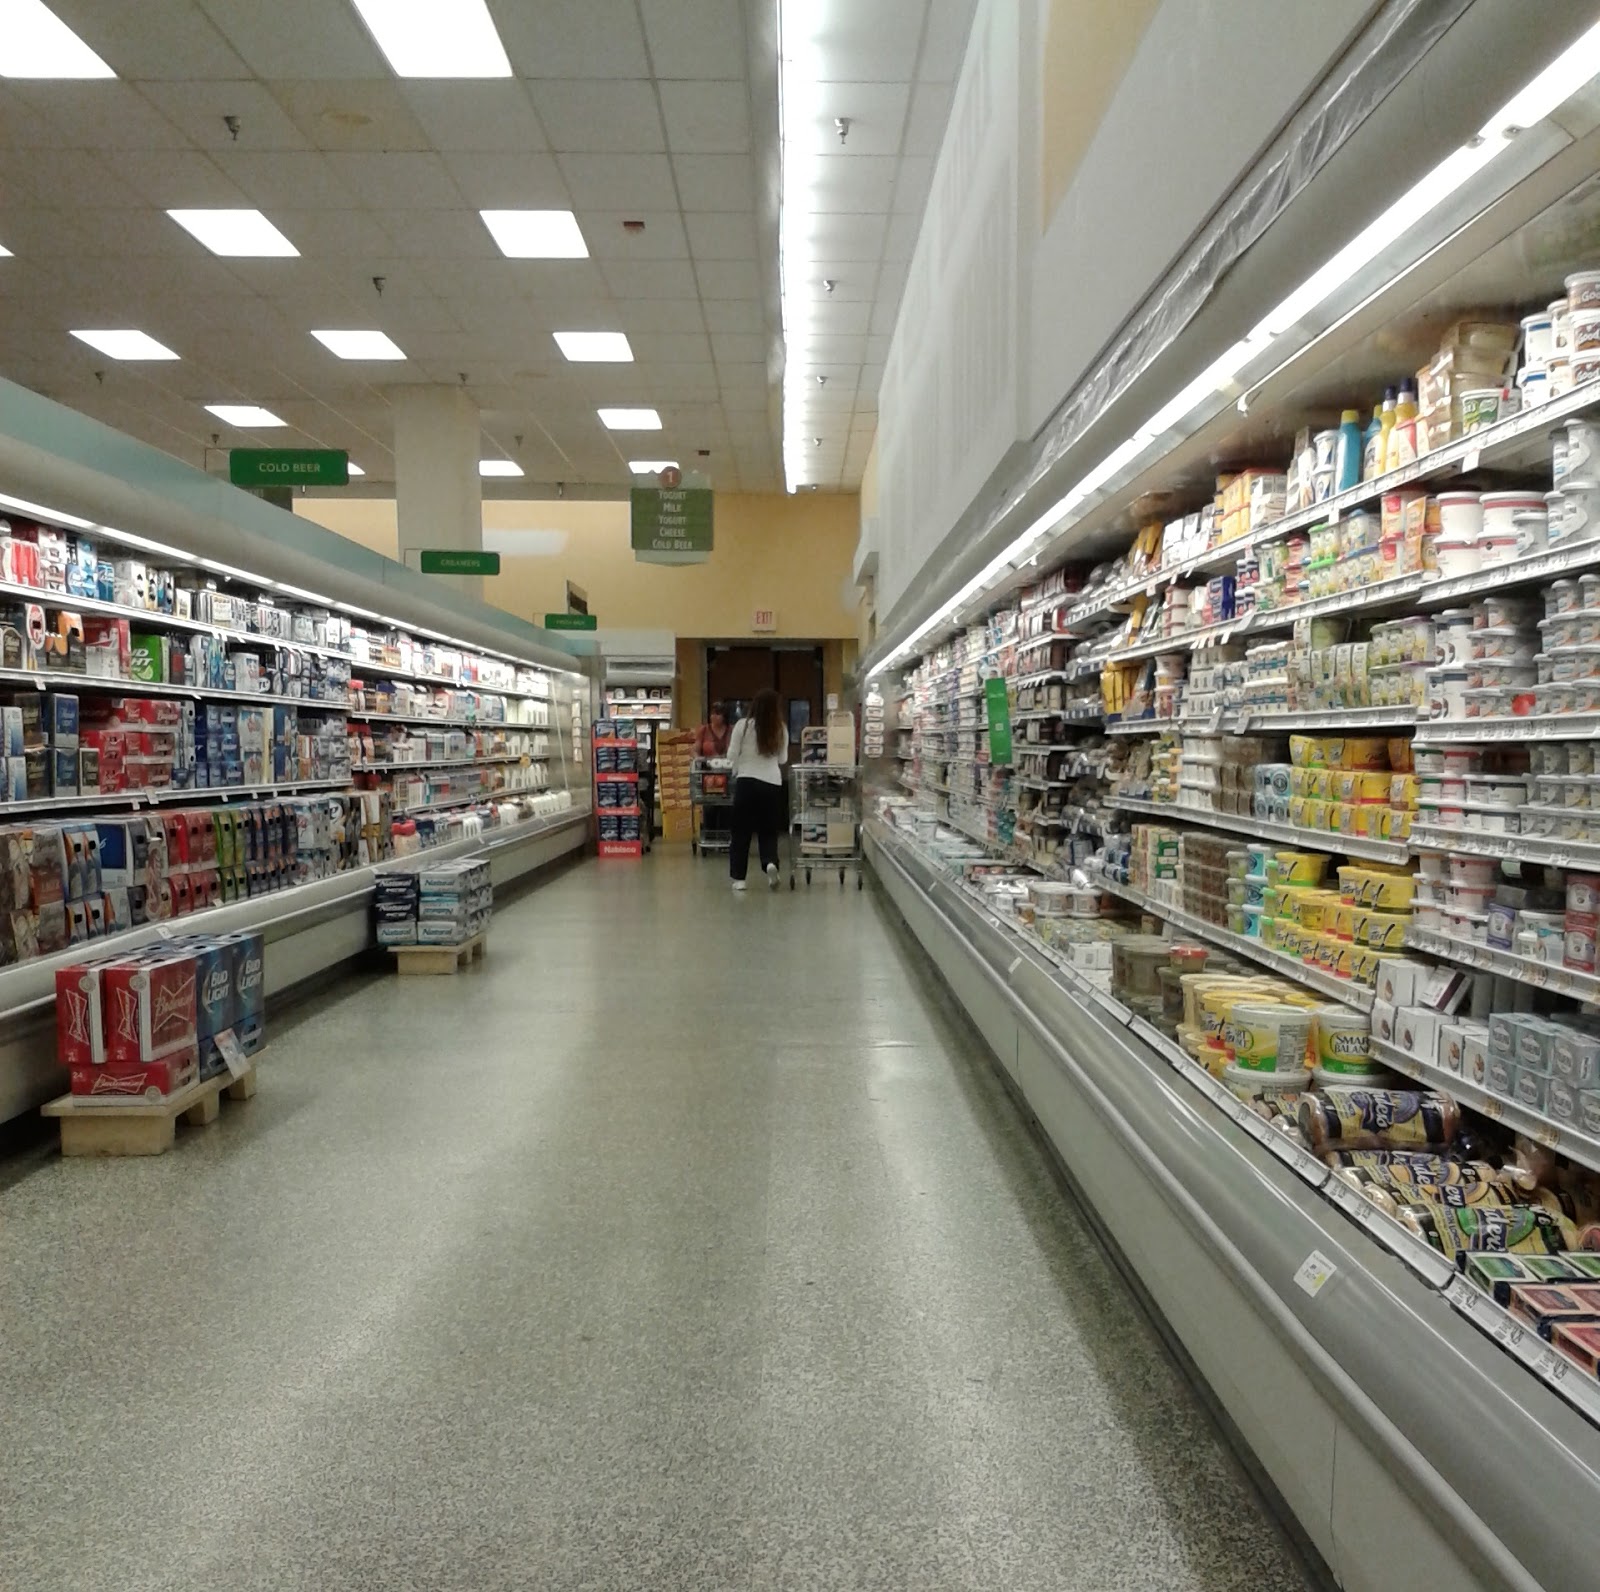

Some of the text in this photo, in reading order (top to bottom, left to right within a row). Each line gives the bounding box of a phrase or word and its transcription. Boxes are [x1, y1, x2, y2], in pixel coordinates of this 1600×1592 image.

[259, 463, 320, 473] COLD BEER
[666, 471, 673, 482] 1
[658, 490, 687, 499] YOGURT
[663, 502, 682, 512] MILK
[658, 514, 687, 525] YOGURT
[660, 527, 686, 537] CHEESE
[652, 539, 693, 549] COLD BEER
[756, 610, 773, 625] EXIT
[604, 846, 636, 854] Nabisco
[245, 958, 261, 975] BUD
[210, 970, 228, 988] BUD
[208, 984, 230, 1001] LIGHT
[1335, 1035, 1369, 1045] SMAR
[1334, 1044, 1369, 1054] BALAN
